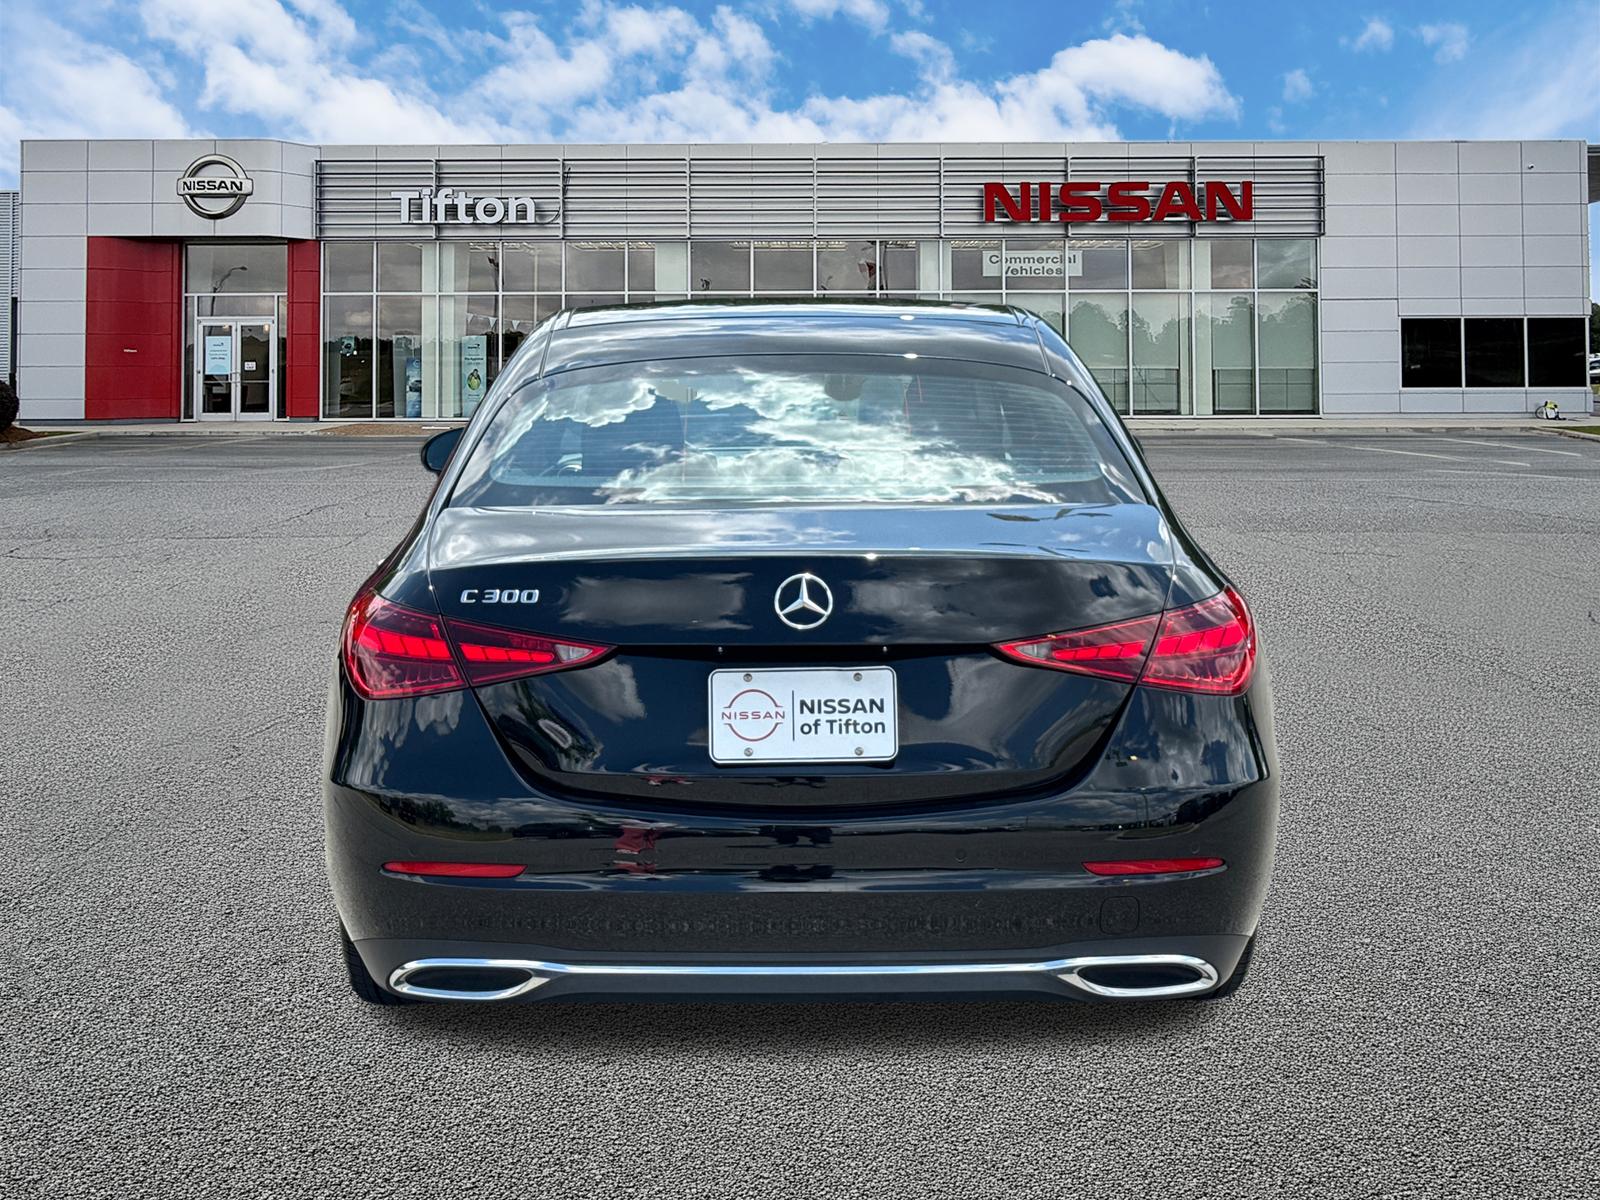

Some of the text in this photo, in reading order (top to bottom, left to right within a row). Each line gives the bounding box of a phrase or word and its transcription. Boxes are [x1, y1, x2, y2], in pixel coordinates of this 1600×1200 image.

[183, 180, 243, 191] NISSAN
[391, 188, 536, 224] Tifton
[984, 180, 1253, 222] NISSAN
[1005, 266, 1063, 275] Vehicles
[460, 589, 540, 603] C 300
[799, 698, 885, 714] NISSAN
[721, 711, 786, 720] NISSAN
[799, 719, 886, 735] of Tifton
